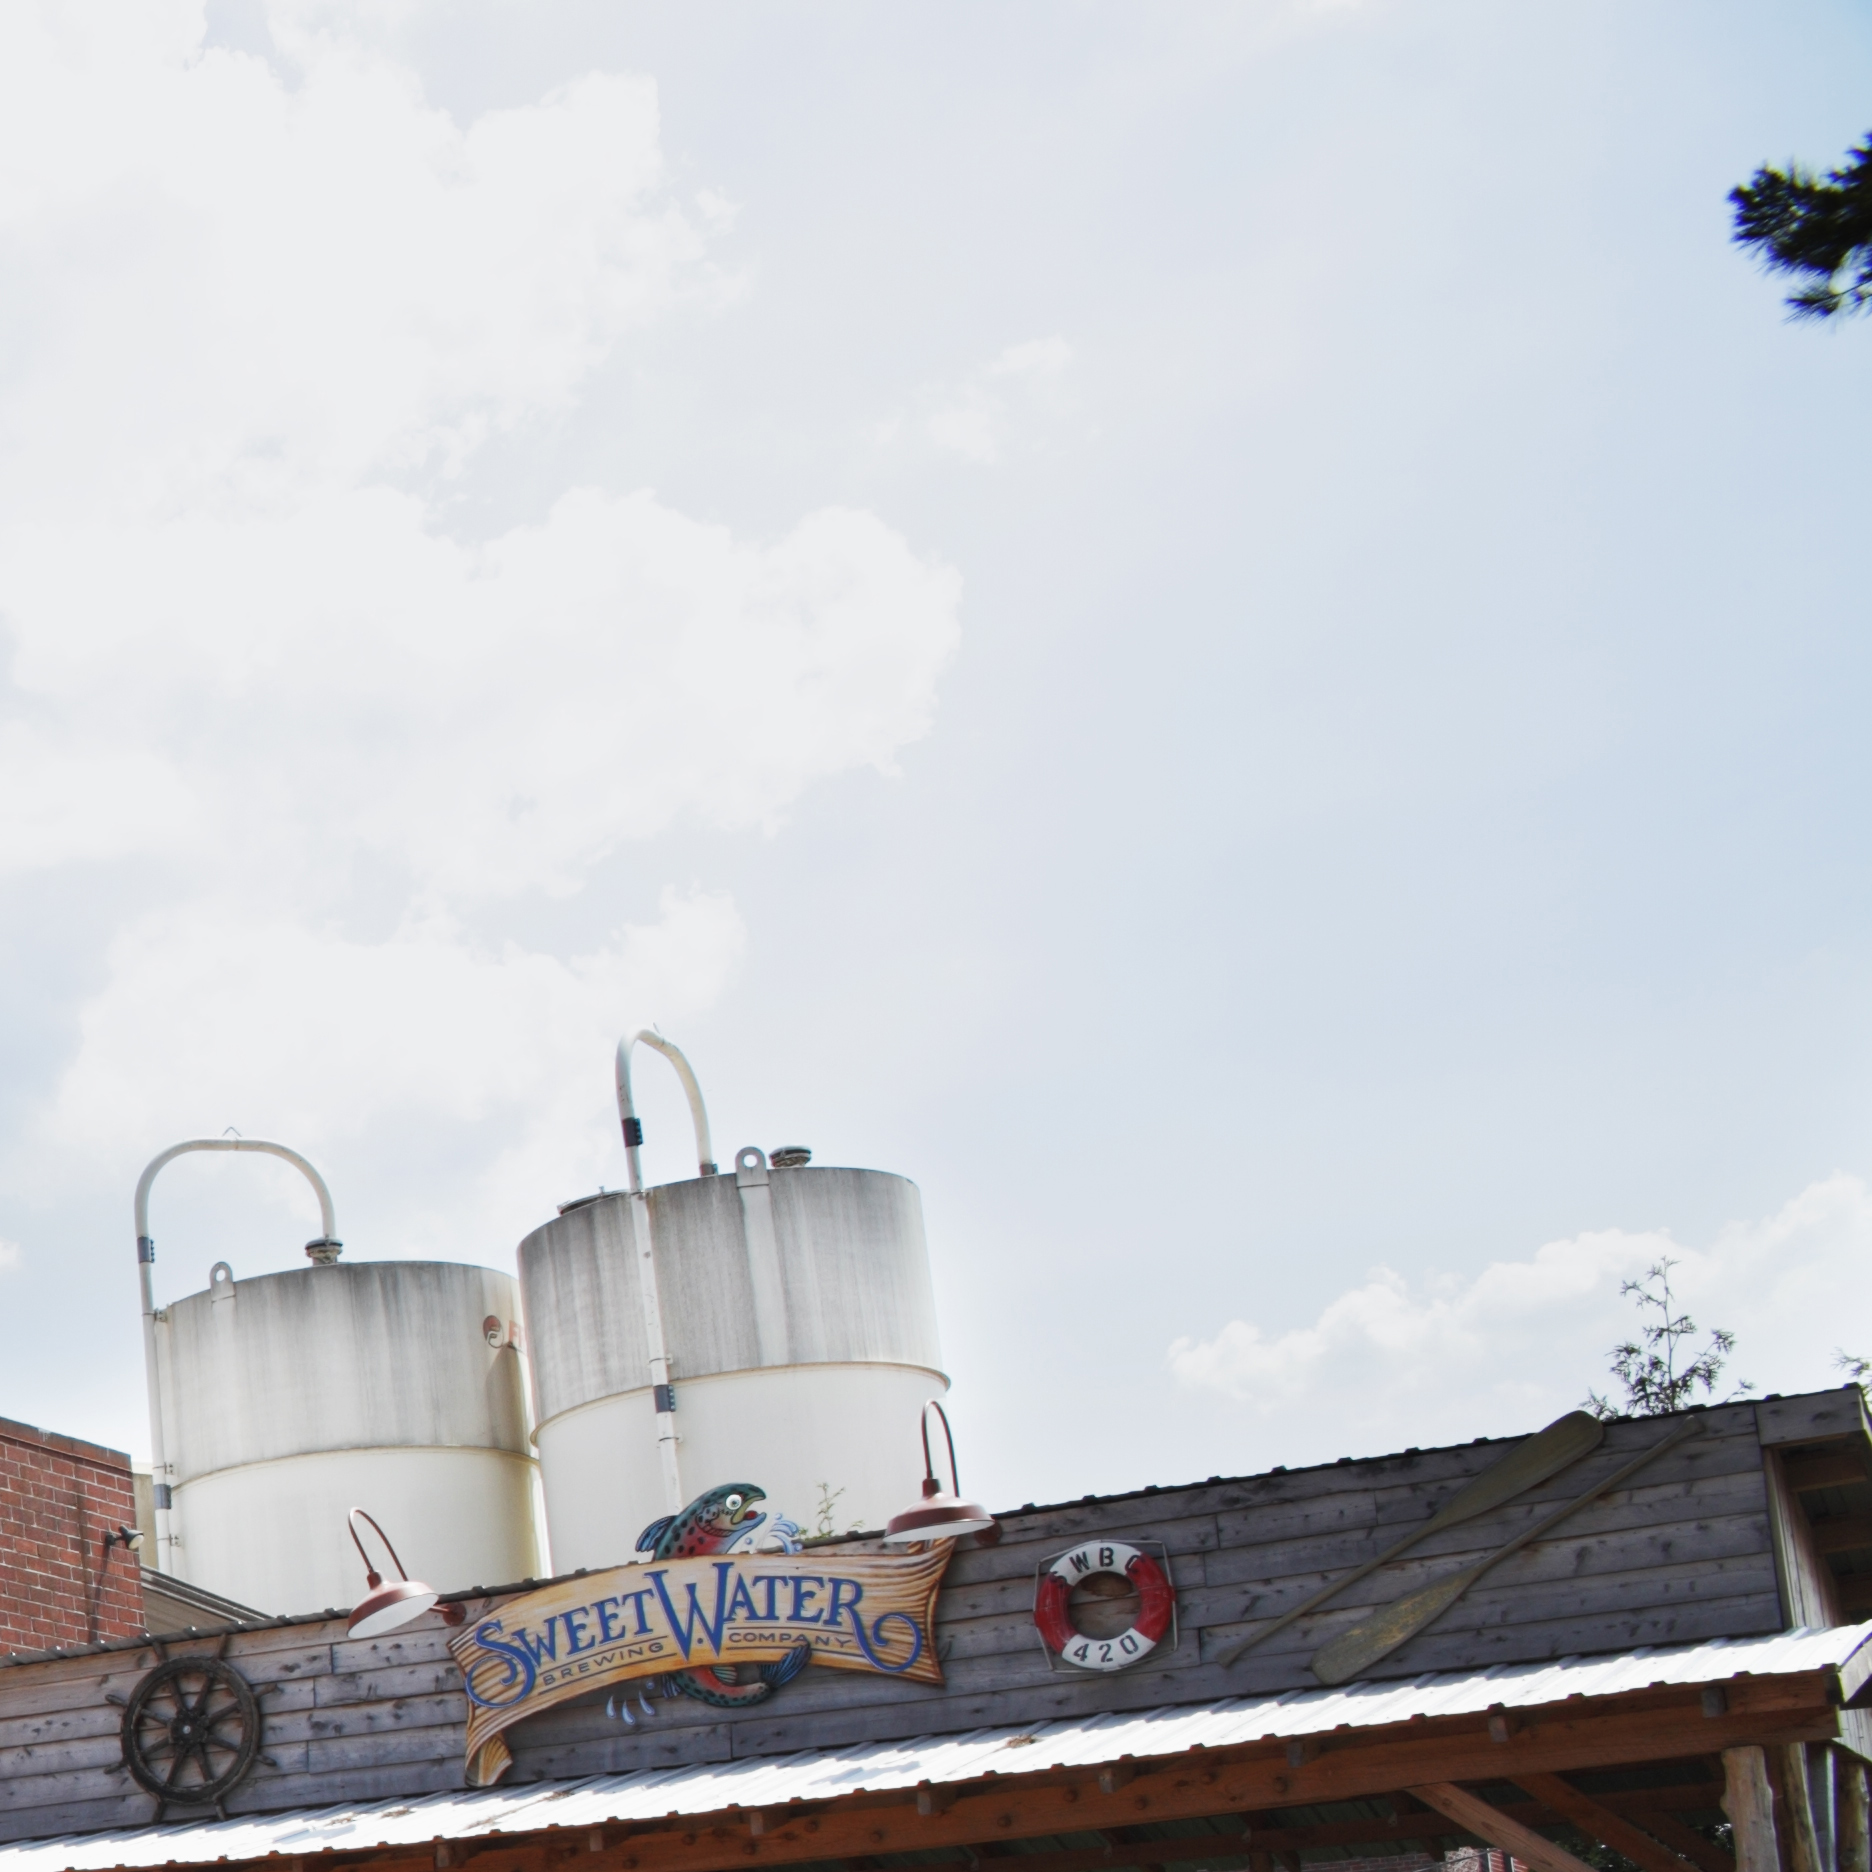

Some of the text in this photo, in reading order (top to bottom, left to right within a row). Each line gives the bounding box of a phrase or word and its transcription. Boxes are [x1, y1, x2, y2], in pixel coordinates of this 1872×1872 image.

[542, 1632, 853, 1687] BREWING COMPANY
[1073, 1634, 1139, 1663] 420
